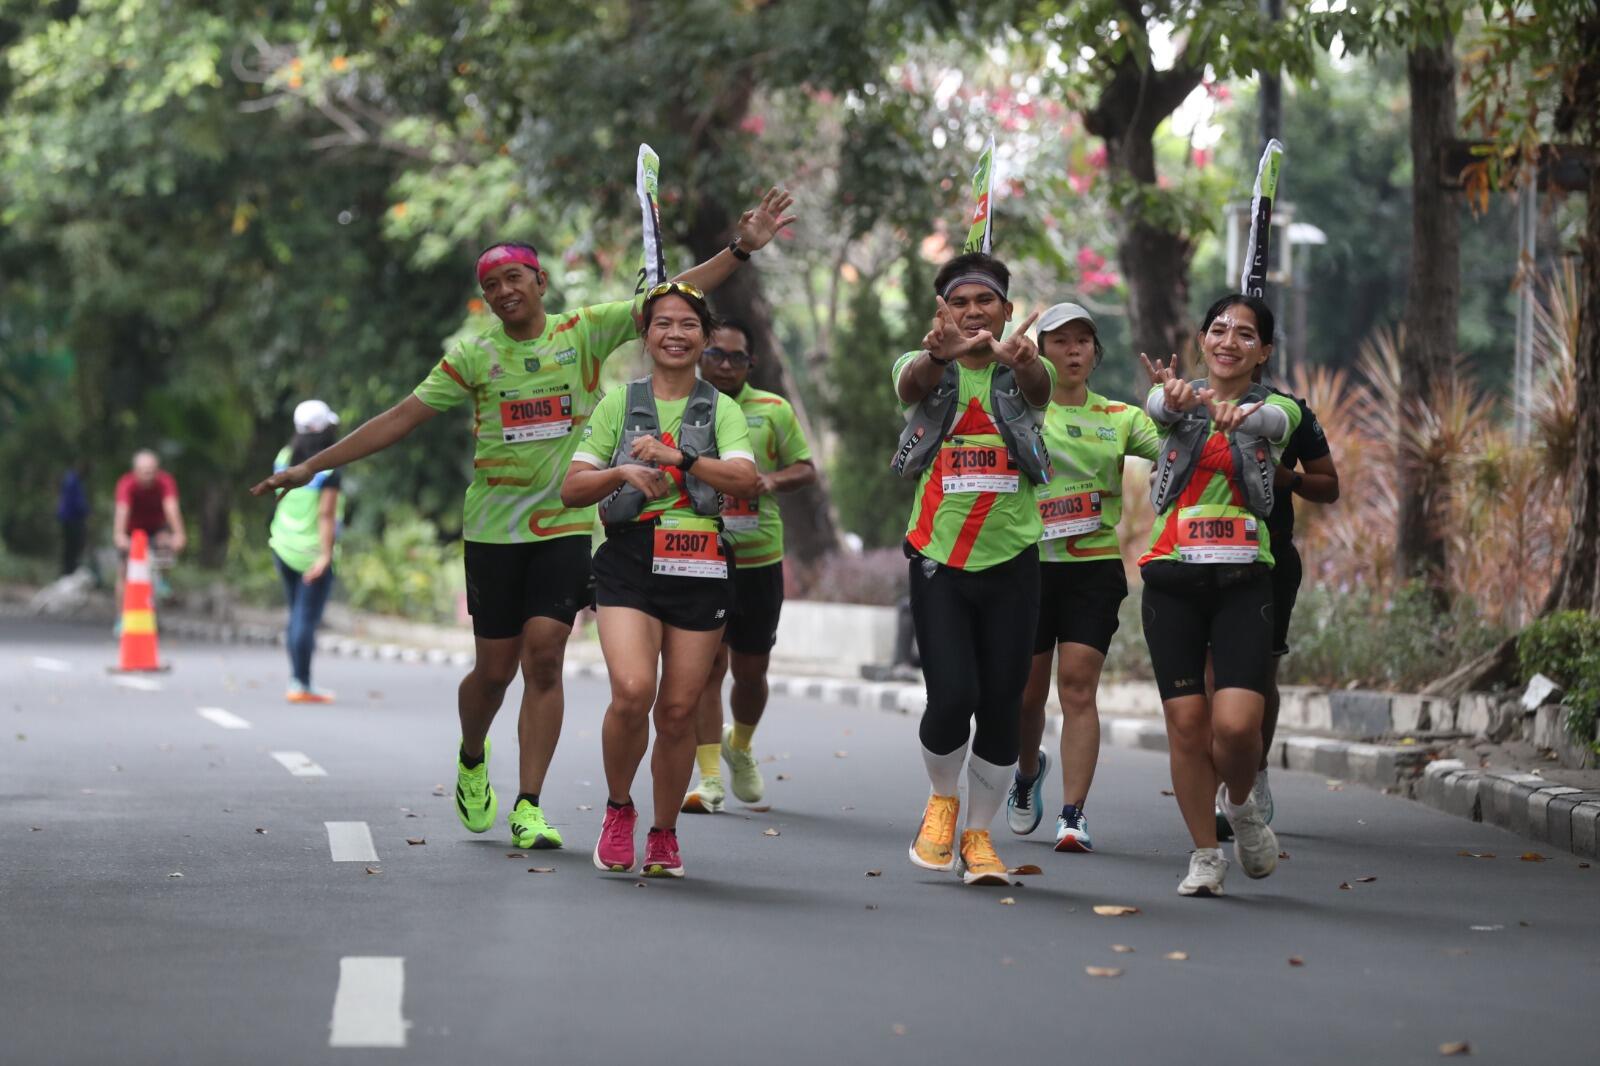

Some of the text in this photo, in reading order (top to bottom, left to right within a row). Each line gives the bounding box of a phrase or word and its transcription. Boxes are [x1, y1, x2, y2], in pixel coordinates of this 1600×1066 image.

[510, 400, 552, 420] 21045
[952, 450, 996, 468] 21308
[1040, 497, 1083, 519] 22003
[1188, 521, 1234, 540] 21309
[665, 533, 709, 552] 21307
